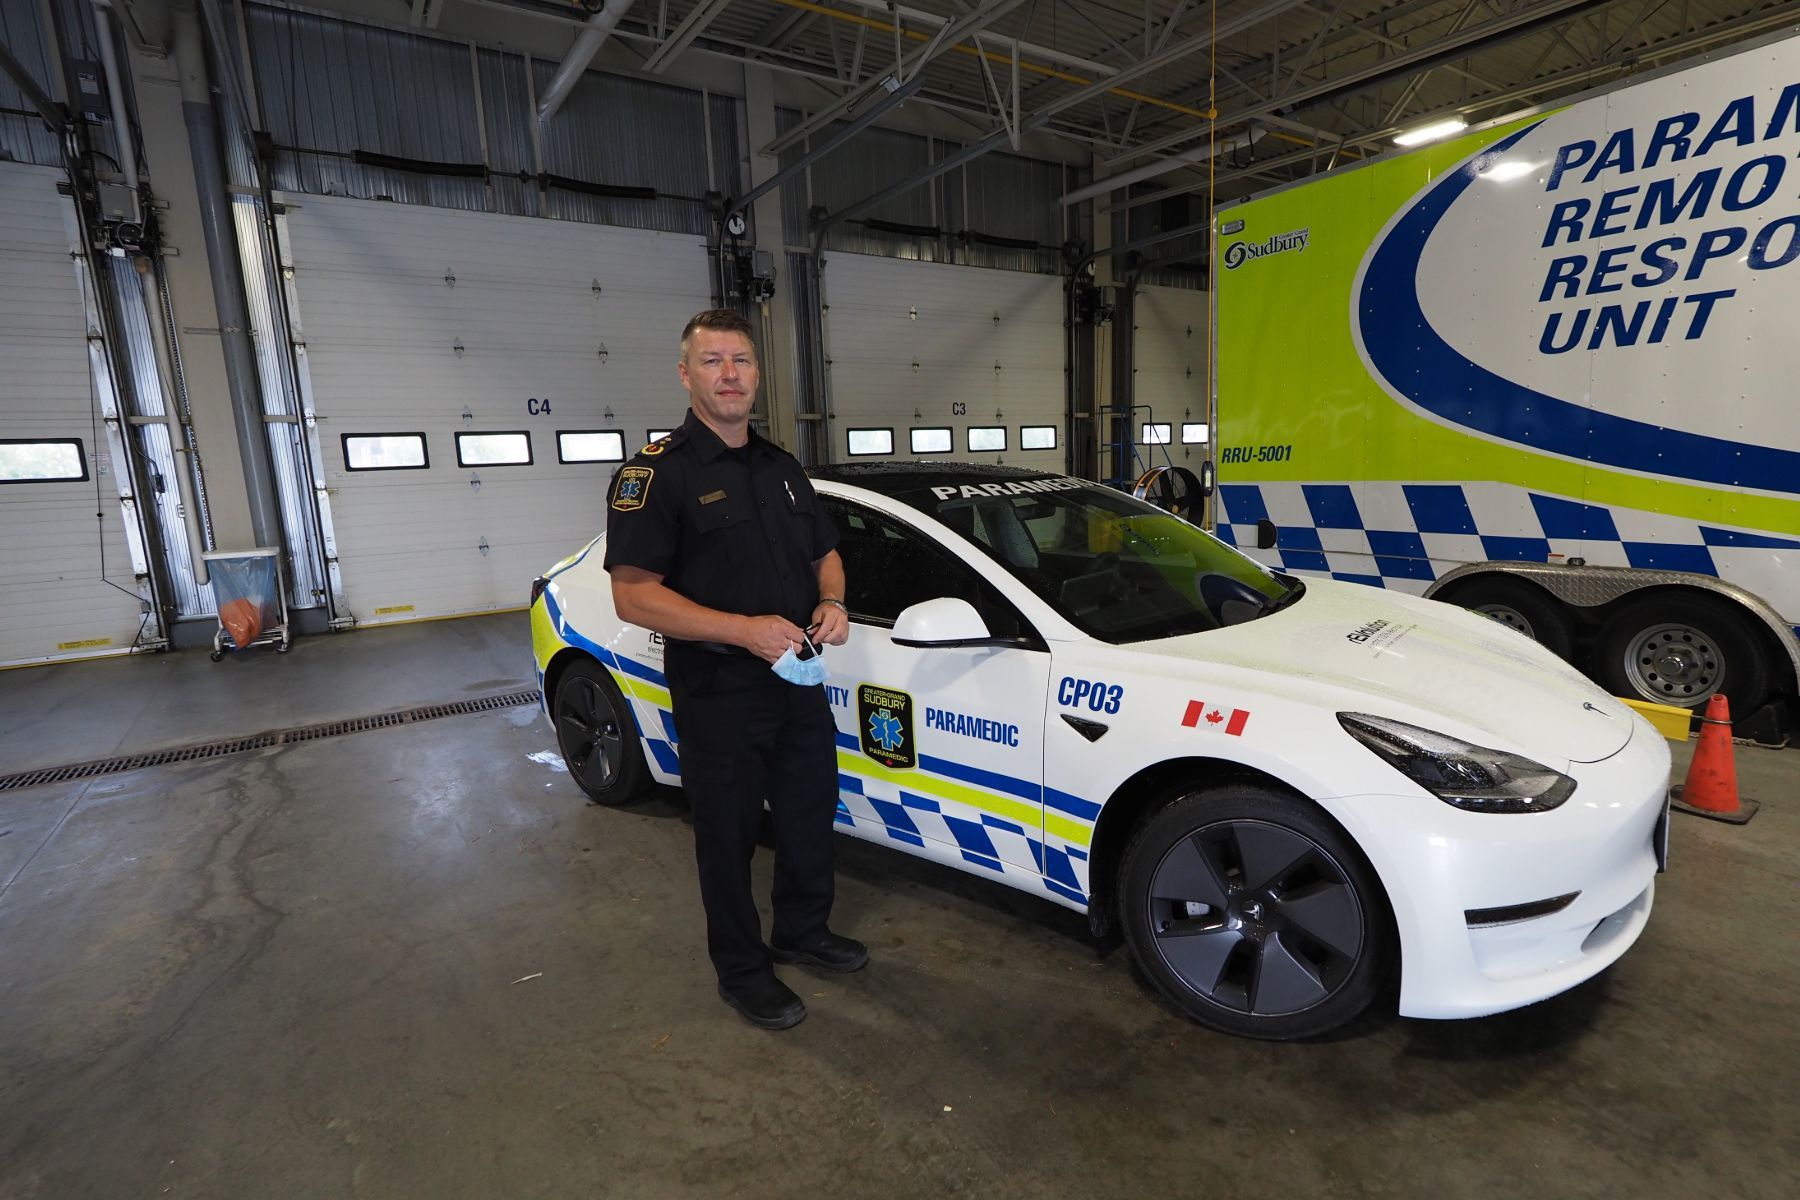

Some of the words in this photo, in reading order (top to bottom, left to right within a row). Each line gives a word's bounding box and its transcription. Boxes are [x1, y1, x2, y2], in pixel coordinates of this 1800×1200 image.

[1541, 155, 1800, 248] REMO
[1248, 233, 1308, 259] Sudbury
[1539, 289, 1737, 355] UNIT
[527, 398, 552, 416] C4
[952, 402, 966, 415] C3
[1221, 445, 1292, 464] RRU-5001
[863, 693, 906, 711] SUDBURY
[926, 707, 1018, 747] PARAMEDIC
[869, 747, 908, 763] PARAMEDIC
